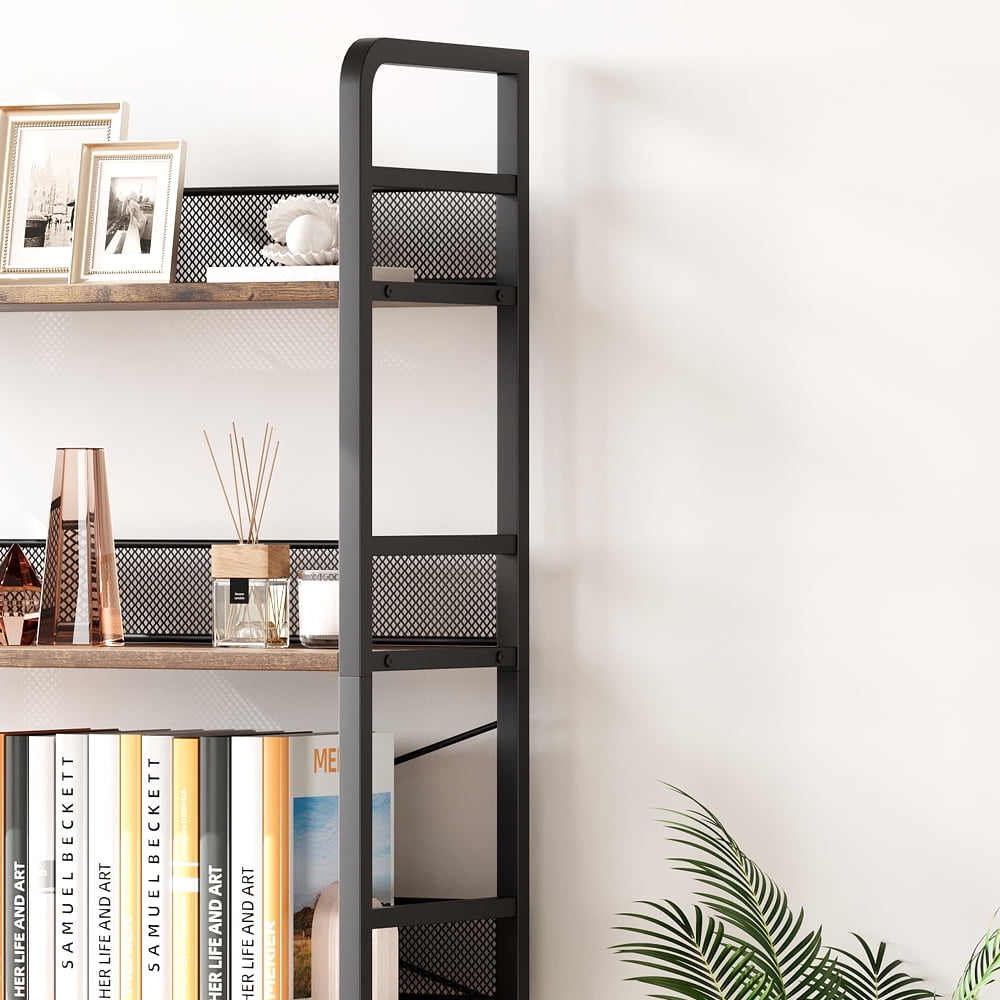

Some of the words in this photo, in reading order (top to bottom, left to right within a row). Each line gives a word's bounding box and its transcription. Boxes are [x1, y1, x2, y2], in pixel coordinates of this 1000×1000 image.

[313, 747, 340, 774] ME
[61, 756, 74, 862] BECKETT
[147, 758, 161, 864] BECKETT
[14, 860, 26, 892] ART
[98, 862, 111, 893] ART
[208, 864, 223, 897] ART
[241, 866, 255, 897] ART
[14, 894, 26, 930] AND
[61, 872, 74, 969] SAMUEL
[98, 896, 111, 931] AND
[147, 874, 161, 972] SAMUEL
[208, 899, 223, 935] AND
[241, 900, 255, 936] AND
[14, 932, 26, 963] LIFE
[98, 935, 111, 965] LIFE
[208, 937, 223, 969] LIFE
[241, 939, 255, 969] LIFE
[263, 919, 277, 999] MERIER
[14, 966, 26, 998] HER
[98, 969, 111, 999] HER
